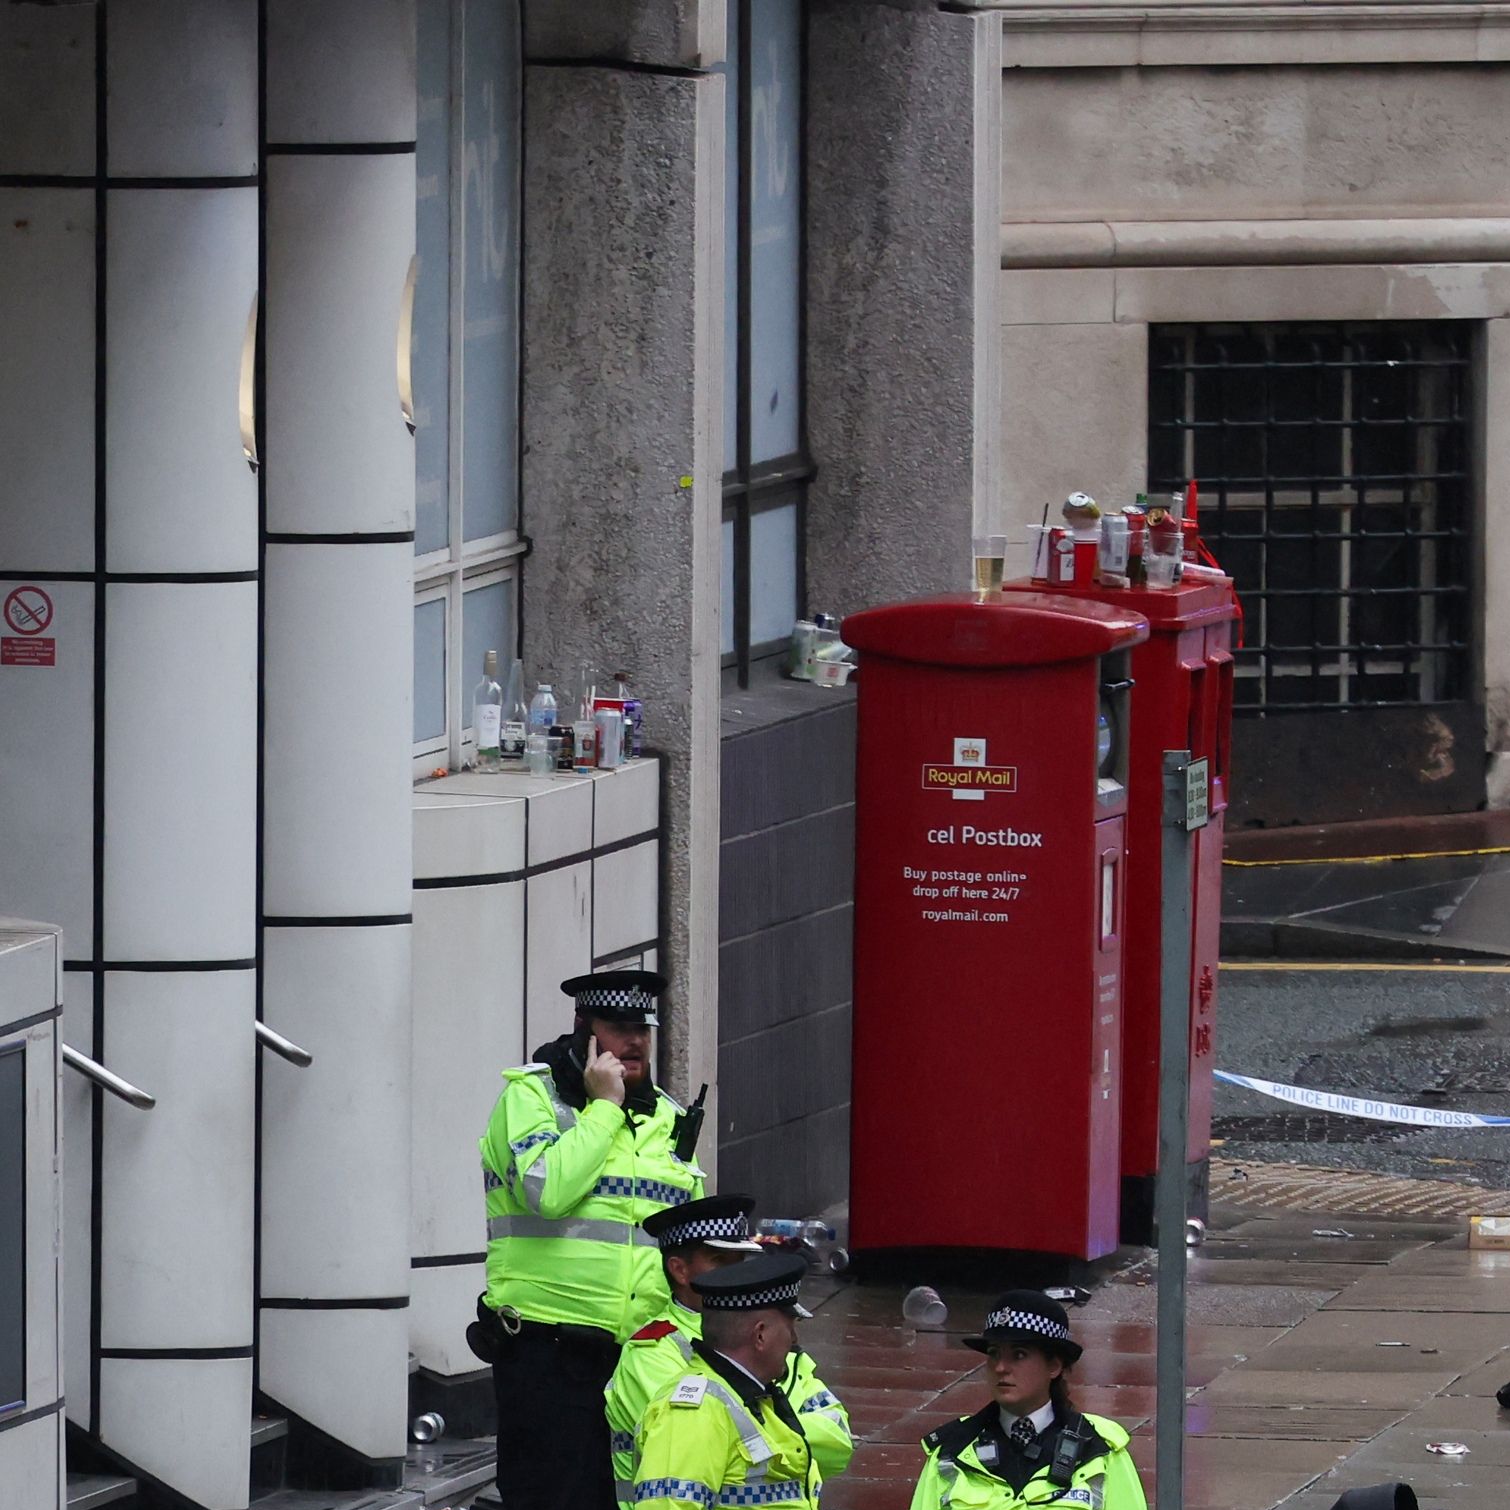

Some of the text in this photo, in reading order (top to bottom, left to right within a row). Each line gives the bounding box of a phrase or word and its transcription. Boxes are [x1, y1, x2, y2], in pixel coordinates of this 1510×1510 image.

[928, 768, 1011, 786] Royal Mail
[961, 826, 1043, 848] Postbox
[903, 866, 928, 882] Buy
[931, 868, 982, 884] postage
[912, 885, 1020, 901] drop off here 24/7
[922, 908, 1009, 922] royalmail.com
[1272, 1084, 1474, 1126] POLICE LINE DO NOT CROSS
